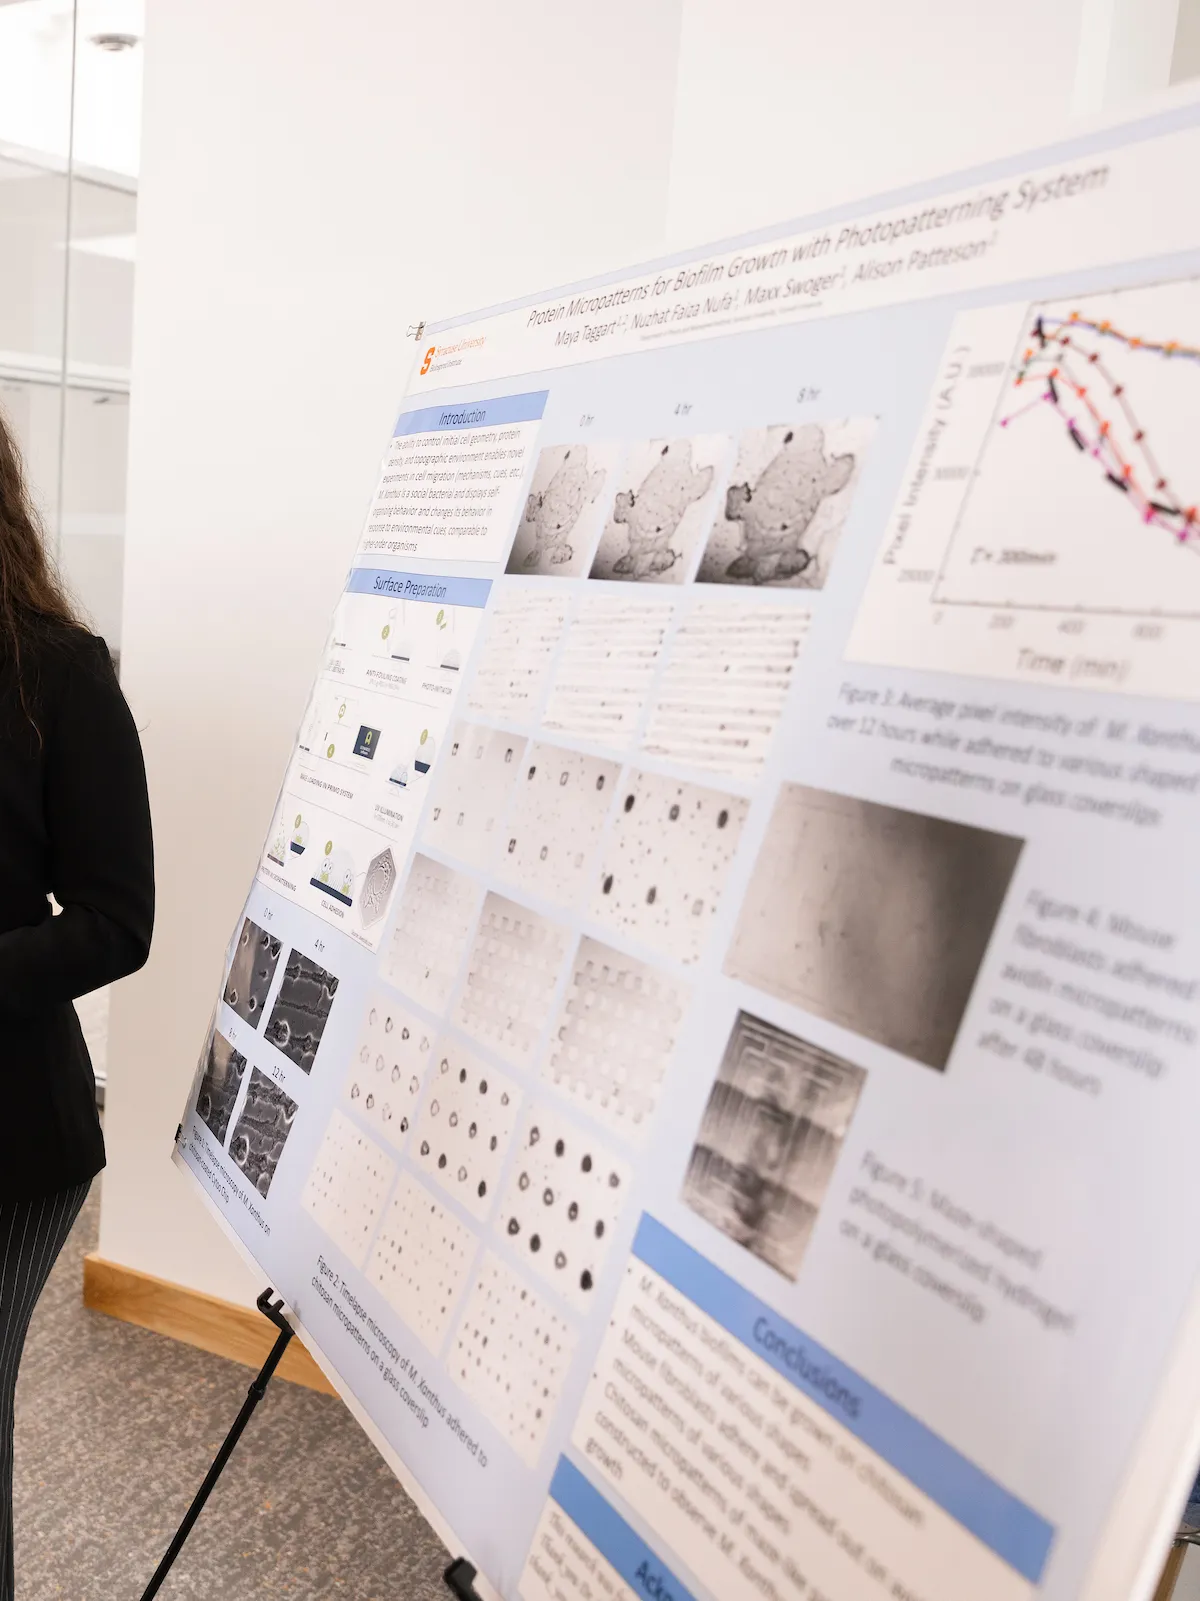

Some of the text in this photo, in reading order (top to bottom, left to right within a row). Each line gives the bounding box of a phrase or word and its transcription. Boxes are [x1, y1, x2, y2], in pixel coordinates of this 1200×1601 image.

[527, 166, 1109, 327] Protein Micropatterns for Biofilm Growth with Photopatterning System
[554, 330, 579, 347] Maya
[630, 307, 671, 330] Nuzhat
[671, 302, 701, 321] Faiza
[744, 283, 780, 305] Maxx
[852, 259, 902, 283] Alison
[439, 409, 486, 426] Introduction
[415, 437, 421, 448] to
[422, 435, 441, 448] control
[442, 434, 459, 446] initial
[460, 433, 471, 445] cell
[470, 431, 498, 446] geometry,
[498, 428, 520, 443] protein
[405, 453, 413, 465] and
[414, 452, 448, 466] topographic
[449, 451, 484, 463] environment
[485, 448, 506, 460] enables
[508, 448, 524, 459] novel
[415, 470, 426, 481] cell
[427, 468, 454, 482] migration
[410, 488, 428, 499] social
[429, 488, 453, 499] bacterial
[454, 488, 465, 499] and
[465, 487, 487, 499] displays
[883, 512, 912, 565] Pixel
[903, 418, 947, 506] Intensity
[393, 506, 418, 517] behavior
[419, 506, 430, 517] and
[430, 506, 453, 518] changes
[461, 506, 485, 517] behavior
[486, 507, 492, 517] in
[391, 523, 432, 535] environmental
[448, 525, 482, 538] comparable
[482, 527, 488, 536] to
[388, 541, 418, 552] organisms
[373, 575, 447, 598] Surface Preparation
[328, 783, 339, 794] PRIMO
[339, 788, 353, 799] SYSTEM
[268, 910, 273, 921] hr
[314, 939, 325, 953] 4 hr
[272, 1065, 286, 1084] 12 hr
[238, 1190, 244, 1199] of
[264, 1224, 270, 1236] on
[311, 1275, 430, 1428] chitosan micropatterns on a glass coverslip
[317, 1255, 334, 1281] Figure
[339, 1281, 367, 1323] Timelapse
[367, 1318, 401, 1363] microscopy
[400, 1357, 409, 1373] of
[408, 1365, 417, 1384] M.
[417, 1379, 447, 1418] Xanthus
[446, 1410, 477, 1456] adhered
[478, 1448, 487, 1468] to
[753, 1316, 860, 1420] Conclusions
[585, 1437, 624, 1481] growth
